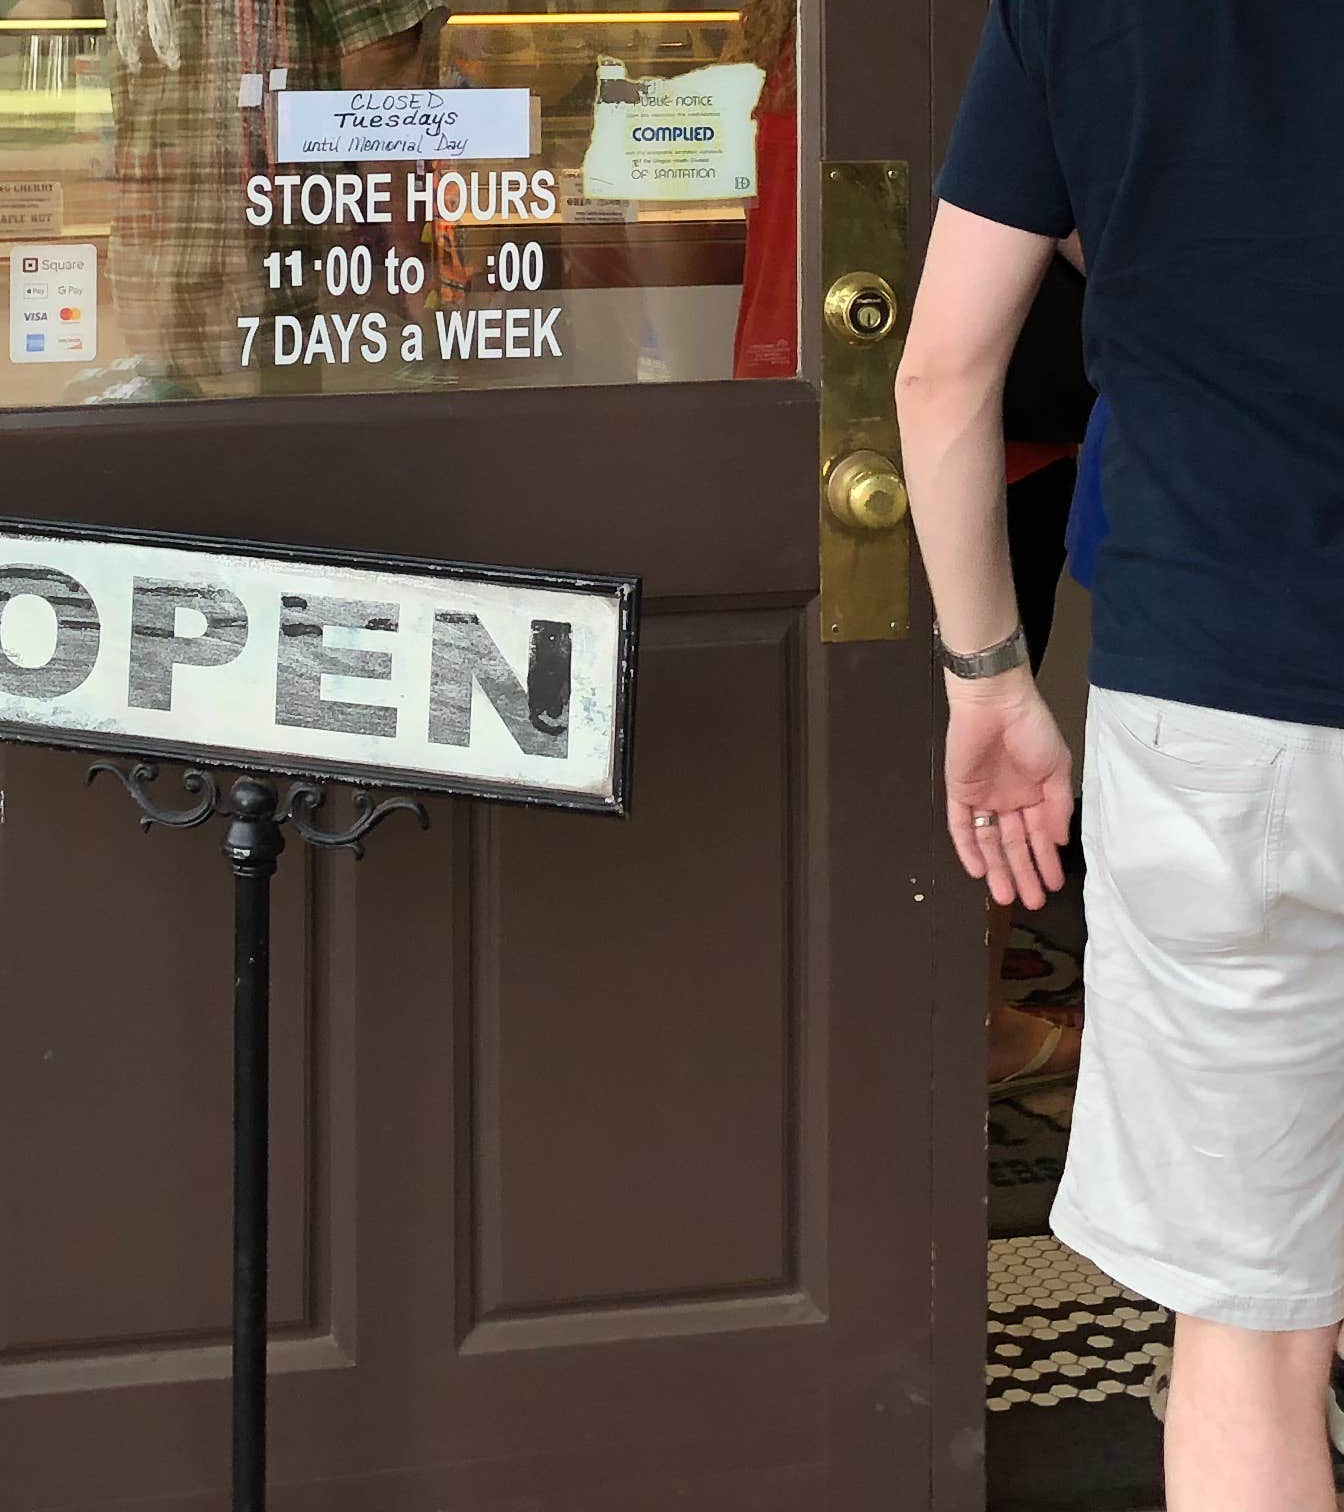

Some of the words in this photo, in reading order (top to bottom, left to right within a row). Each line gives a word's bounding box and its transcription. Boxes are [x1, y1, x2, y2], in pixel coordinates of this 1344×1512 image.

[350, 93, 444, 111] CLOSED
[333, 110, 458, 136] Tuesdays
[632, 126, 715, 142] COMPLIED
[302, 136, 340, 153] until
[348, 135, 423, 153] Memorial
[434, 134, 469, 156] Day
[245, 172, 393, 227] STORE
[407, 169, 557, 223] HOURS
[42, 259, 85, 272] Square
[384, 245, 425, 295] to
[24, 312, 48, 321] VISA
[237, 316, 260, 367] 7
[274, 312, 388, 366] DAYS
[400, 322, 424, 362] a
[435, 307, 563, 361] WEEK
